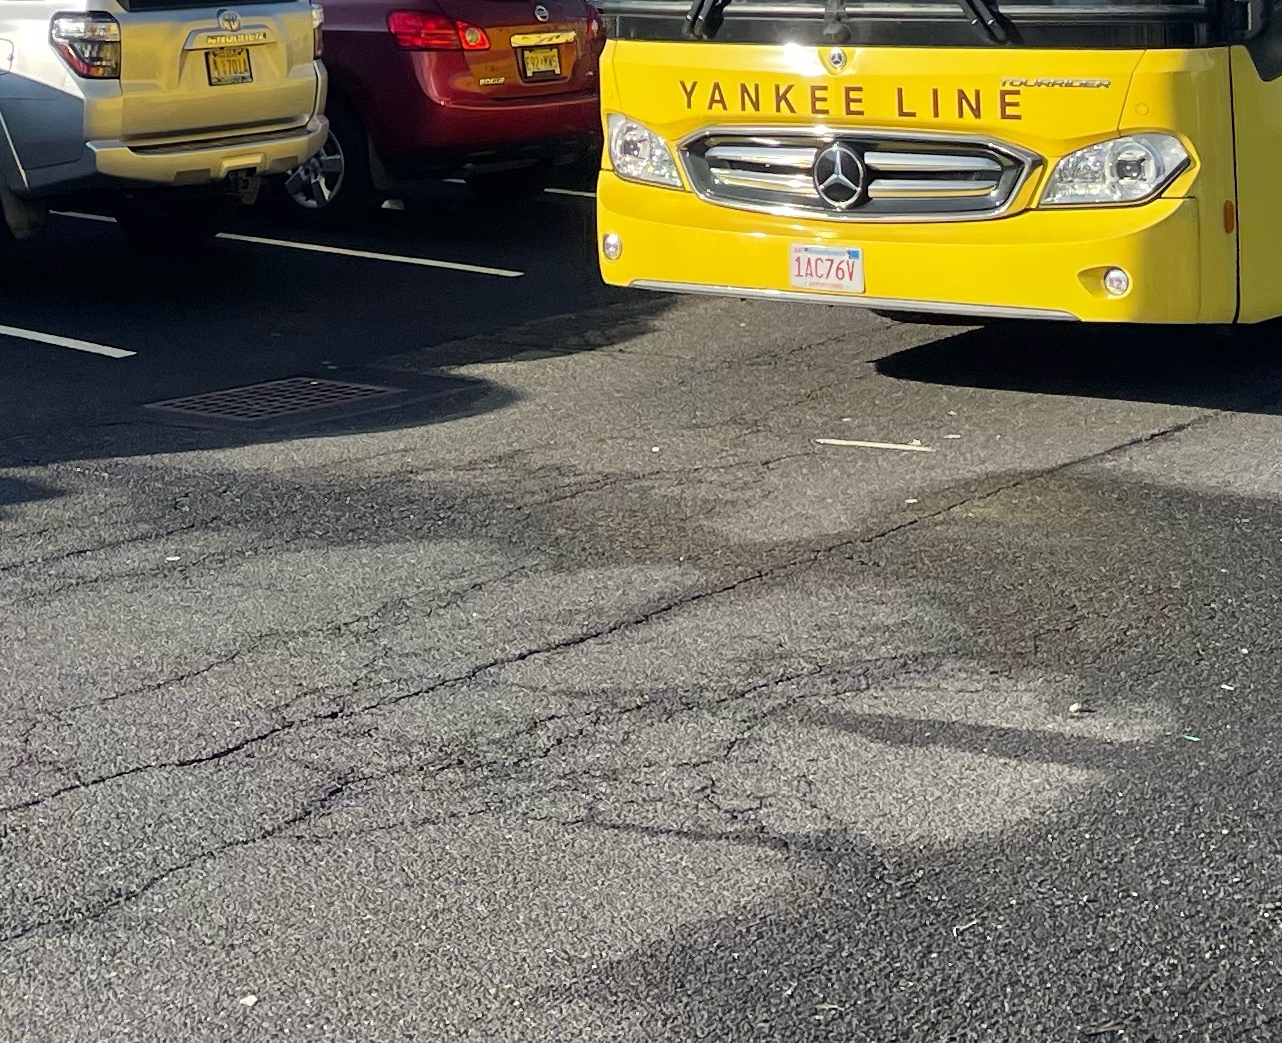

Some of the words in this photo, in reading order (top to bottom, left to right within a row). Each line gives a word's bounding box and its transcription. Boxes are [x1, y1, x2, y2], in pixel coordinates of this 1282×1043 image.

[678, 79, 866, 117] YANKEE
[896, 86, 1023, 121] LINE
[794, 256, 856, 282] 1AC76V
